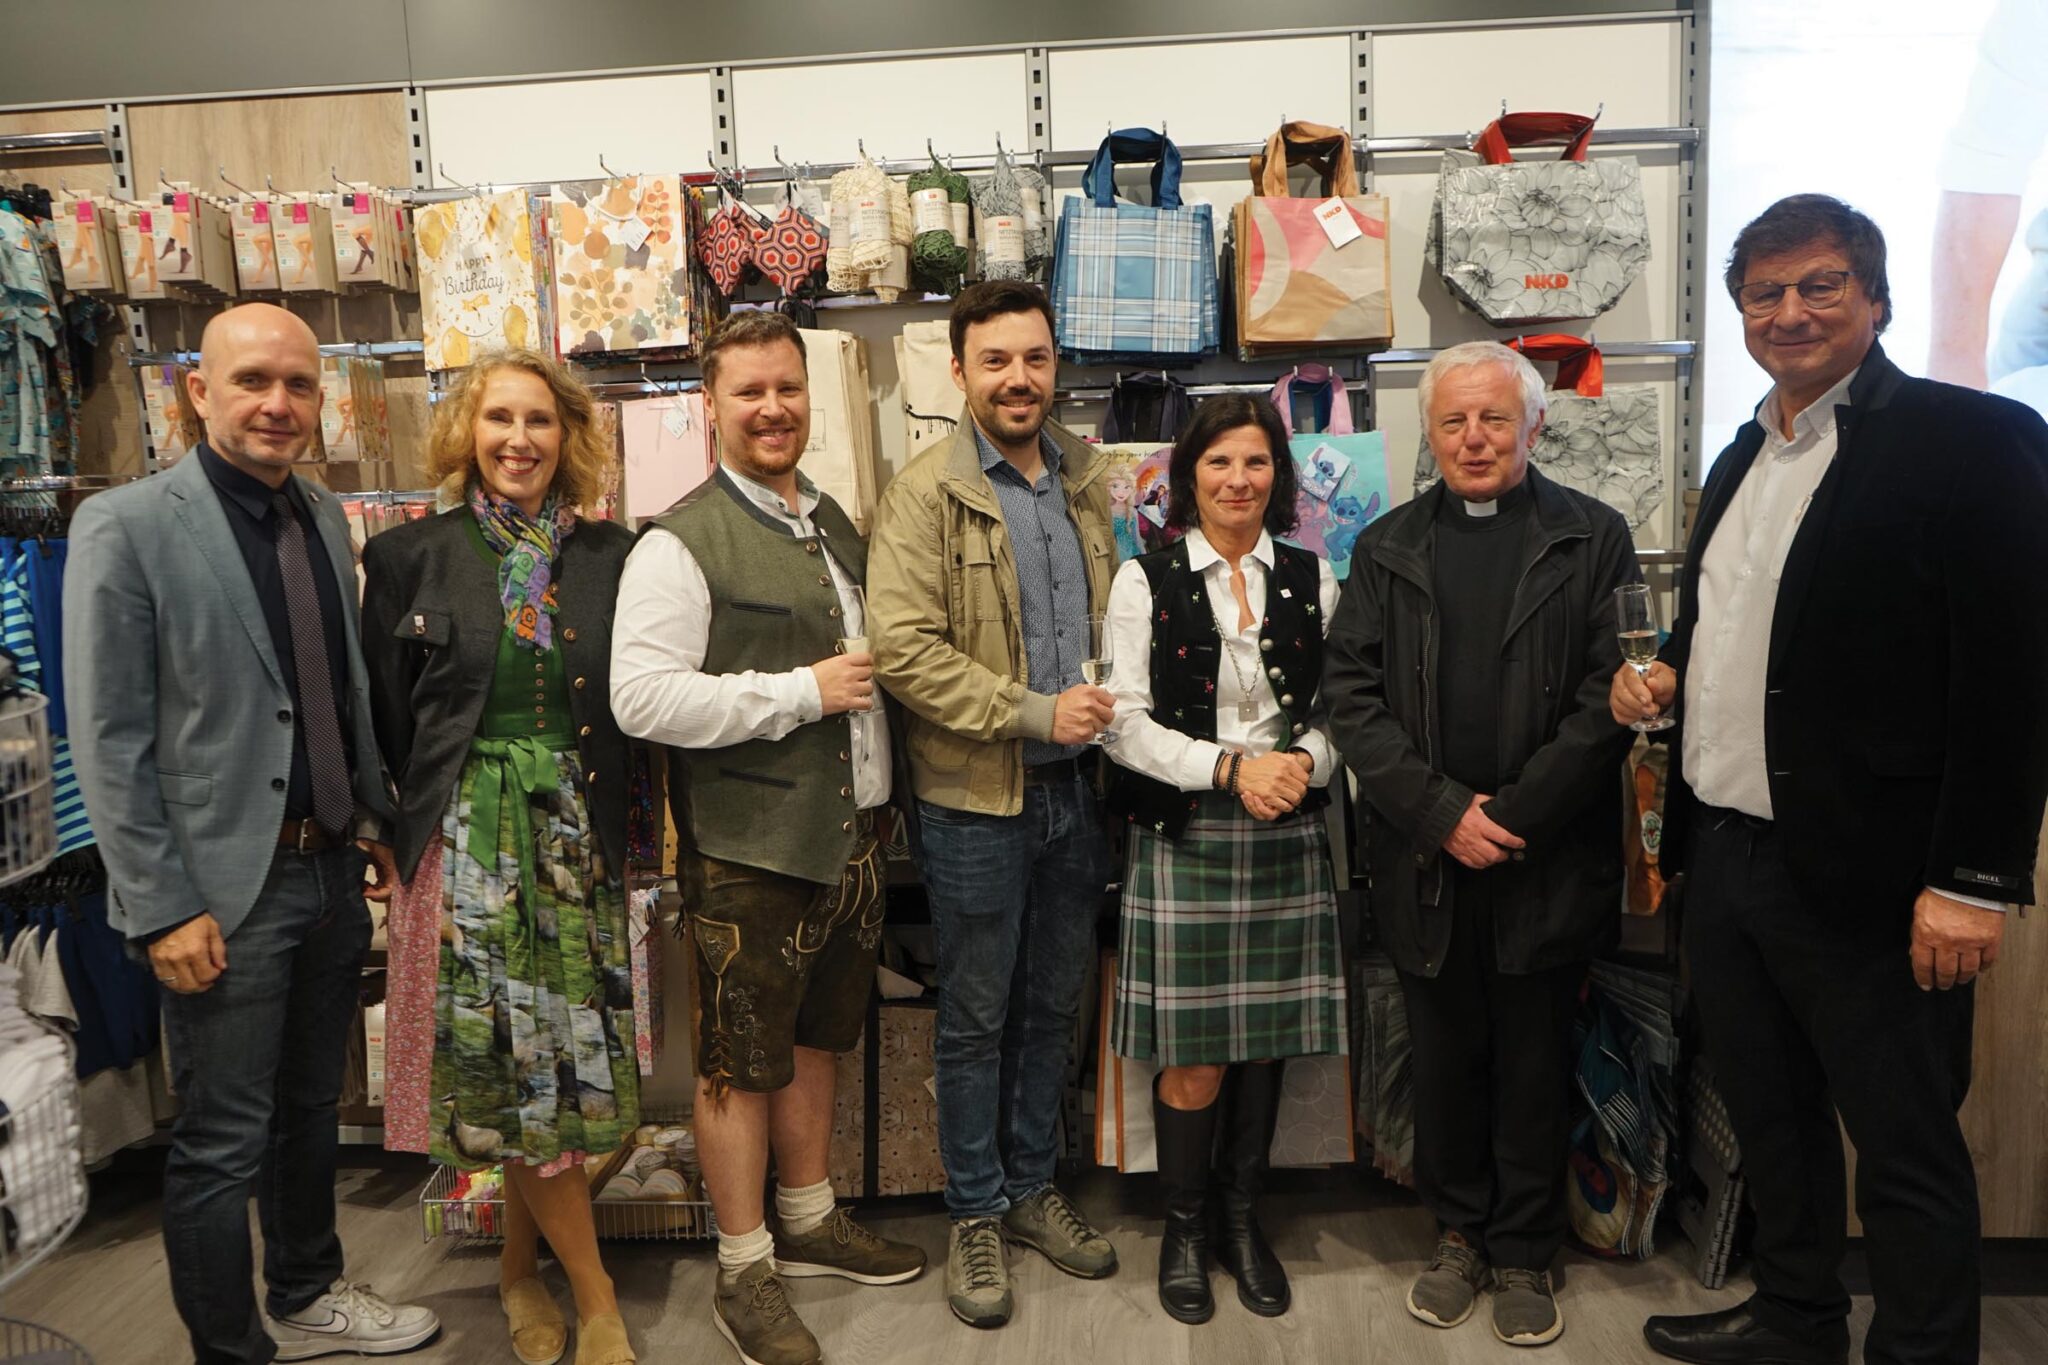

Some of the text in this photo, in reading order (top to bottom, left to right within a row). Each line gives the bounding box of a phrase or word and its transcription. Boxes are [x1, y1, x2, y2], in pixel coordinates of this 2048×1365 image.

[1322, 206, 1342, 220] NKD
[455, 256, 487, 271] HAPPY
[442, 270, 504, 296] Birthday
[1524, 273, 1570, 289] NKD
